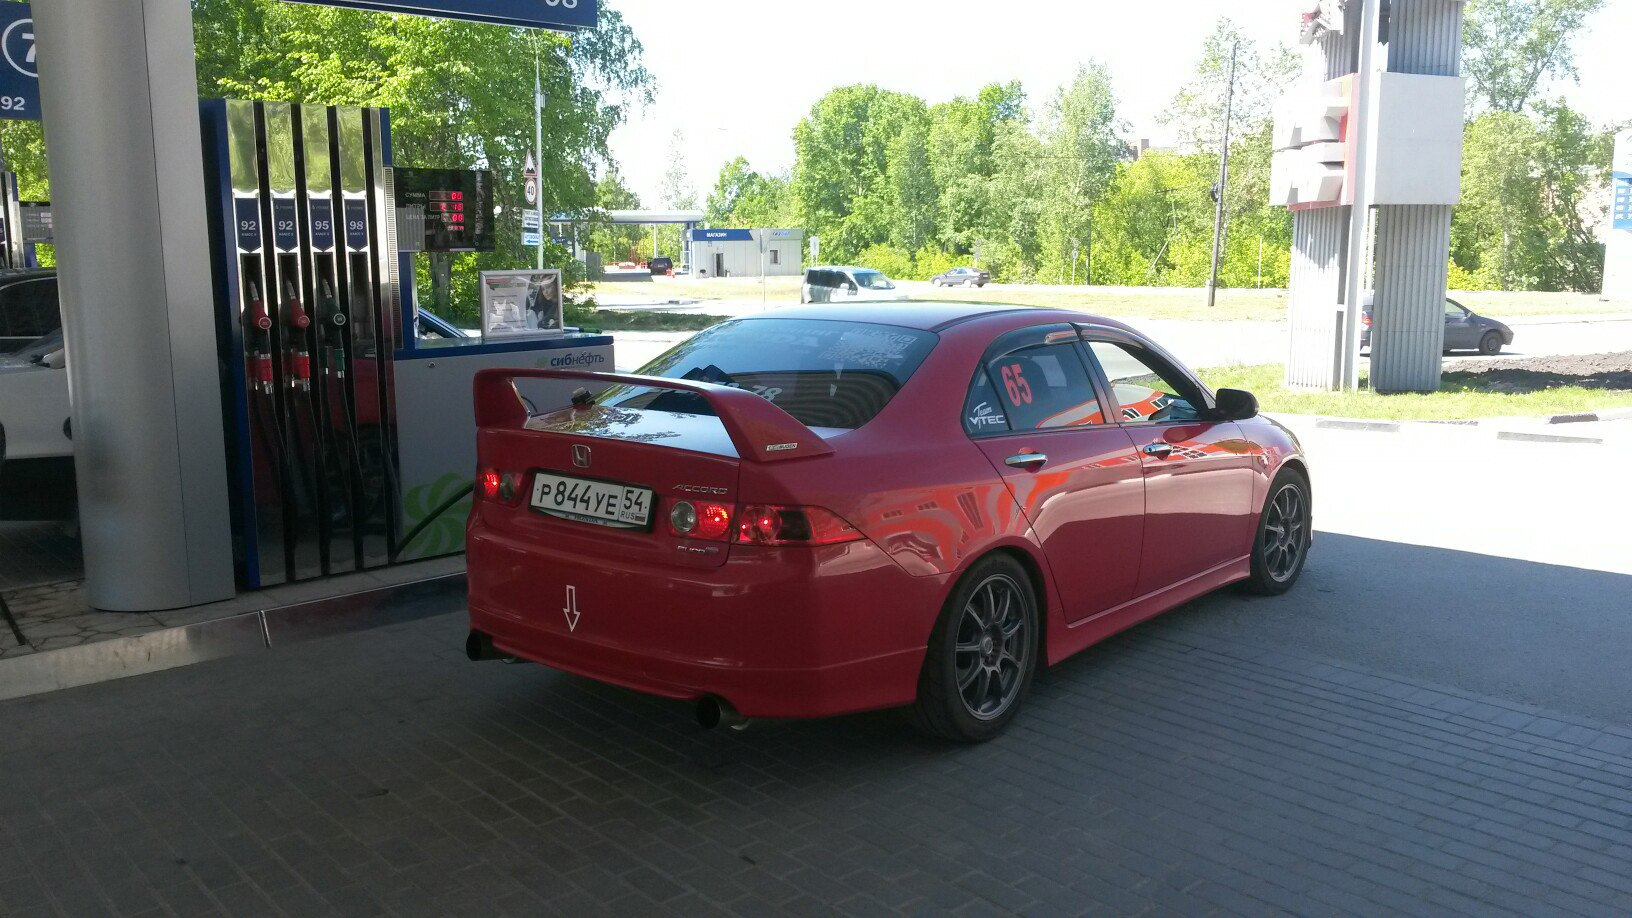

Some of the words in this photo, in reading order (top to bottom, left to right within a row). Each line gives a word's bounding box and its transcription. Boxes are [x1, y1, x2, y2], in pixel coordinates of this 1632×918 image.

[0, 96, 25, 110] 92
[527, 185, 534, 195] 40
[241, 220, 257, 231] 92
[278, 220, 293, 230] 92
[314, 220, 330, 230] 95
[349, 220, 364, 230] 98
[550, 352, 605, 366] сибнефть
[1001, 364, 1033, 407] 65
[973, 402, 992, 420] Team
[969, 415, 1005, 425] VTEC
[672, 484, 728, 494] ACCORD
[623, 489, 643, 512] 54
[620, 511, 635, 520] RUS
